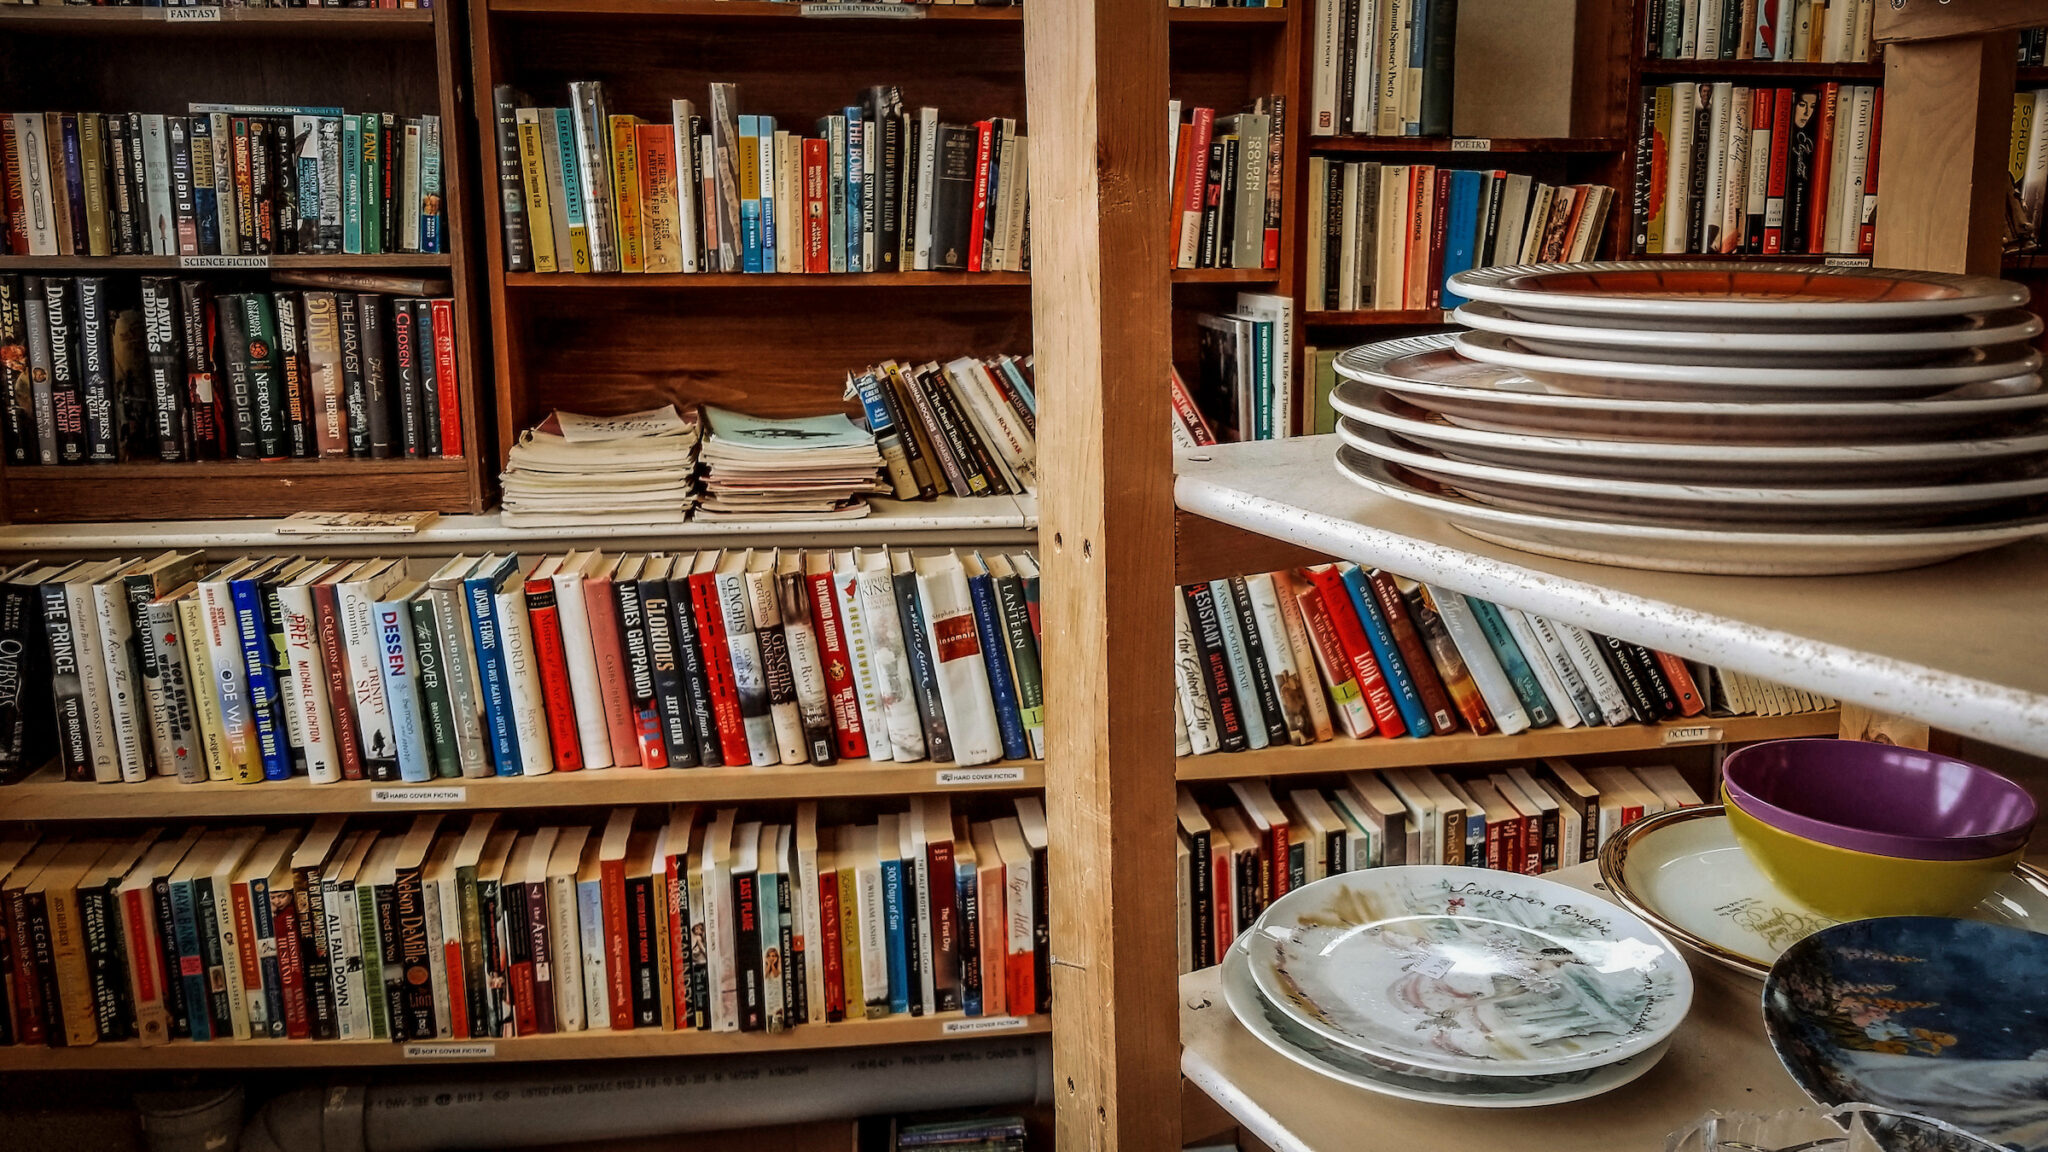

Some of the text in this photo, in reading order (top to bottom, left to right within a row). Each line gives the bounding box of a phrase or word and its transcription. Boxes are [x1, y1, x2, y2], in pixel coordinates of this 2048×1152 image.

[170, 9, 217, 18] FANTASY
[1386, 72, 1396, 99] Poetry
[363, 133, 376, 163] FANE
[849, 120, 862, 184] THE BOMB
[981, 131, 990, 150] SOFT
[1454, 140, 1488, 149] POETRY
[1695, 113, 1708, 188] CLIFF RICHARD
[1774, 96, 1789, 191] JENNIFER HUDSON
[1856, 99, 1870, 151] front row
[2015, 105, 2031, 171] SCHULZ
[132, 138, 144, 183] WIND CHILD
[280, 143, 289, 188] HALO
[560, 120, 578, 215] THE PERIODIC TABLE
[648, 150, 659, 215] PLAYED WITH FIRE
[658, 169, 667, 185] GIRL
[981, 152, 988, 161] IN
[1192, 149, 1205, 209] YOSHIMOTO
[1252, 141, 1262, 191] GOLDEN
[1633, 138, 1646, 215] WALLY LAMB
[173, 172, 190, 211] plan B
[309, 160, 318, 218] SHADOW DAWN
[659, 189, 668, 204] WHO
[978, 178, 986, 198] HEAD
[1414, 170, 1425, 241] POETICAL WORKS
[652, 219, 662, 250] LARSSON
[661, 219, 669, 239] STIEG
[184, 258, 267, 267] SCIENCE FICTION
[29, 304, 42, 362] DAVE DUNCAN
[46, 286, 70, 381] DAVID EDDINGS
[81, 284, 105, 372] DAVID EDDINGS
[142, 288, 161, 353] EDDINGS
[156, 297, 172, 343] DAVID
[308, 299, 332, 353] DUNE
[341, 300, 359, 375] THE HARVEST
[396, 312, 411, 368] CHOSEN
[52, 392, 70, 433] KNIGHT
[66, 390, 82, 434] THE RUBY
[85, 395, 100, 420] KELL
[98, 399, 111, 440] SEERESS
[154, 369, 171, 437] HIDDEN CITY
[167, 394, 175, 411] THE
[231, 362, 252, 433] PRODIGY
[254, 372, 273, 432] NECROPOLIS
[322, 363, 340, 439] FRANK HERBERT
[929, 393, 967, 460] The Choral Tradition
[996, 417, 1023, 455] ROCK STAR
[345, 594, 361, 646] Cumming
[357, 602, 369, 636] Charles
[472, 588, 495, 650] JOSHUA FERRIS
[619, 584, 653, 698] JAMES GRIPPANDO
[815, 579, 840, 652] RAYMOND KHOURY
[1002, 584, 1026, 650] LANTERN
[1217, 584, 1249, 692] YANKEE DOODLE DIXIE
[382, 611, 406, 677] DESSEN
[419, 642, 438, 688] PLOVER
[507, 625, 526, 677] FFORDE
[645, 598, 684, 745] GLORIOUS JEFF GUINN
[677, 602, 710, 737] so much pretty cara hoffman
[794, 631, 814, 696] Bitter River
[42, 591, 85, 762] THE PRINCE VITO BRUSCHINI
[288, 614, 321, 743] PREY MICHAEL CRICHTON
[356, 680, 368, 706] SIX
[368, 666, 385, 716] TRINITY
[1209, 653, 1239, 733] MICHAEL PALMER
[1353, 651, 1397, 722] LOOK AGAIN
[1386, 652, 1414, 701] LISA SEE
[147, 685, 169, 741] Jo Baker
[218, 657, 245, 754] CODE WHITE
[1668, 728, 1704, 738] OCCULT
[433, 791, 459, 799] FICTION
[1446, 814, 1459, 854] Daniel
[396, 871, 427, 963] Nelson DeMille
[739, 878, 754, 932] LAST PLANE
[886, 866, 899, 931] 300 Days of Sun
[32, 917, 49, 964] SECRET
[328, 914, 349, 1007] ALL FALL DOWN
